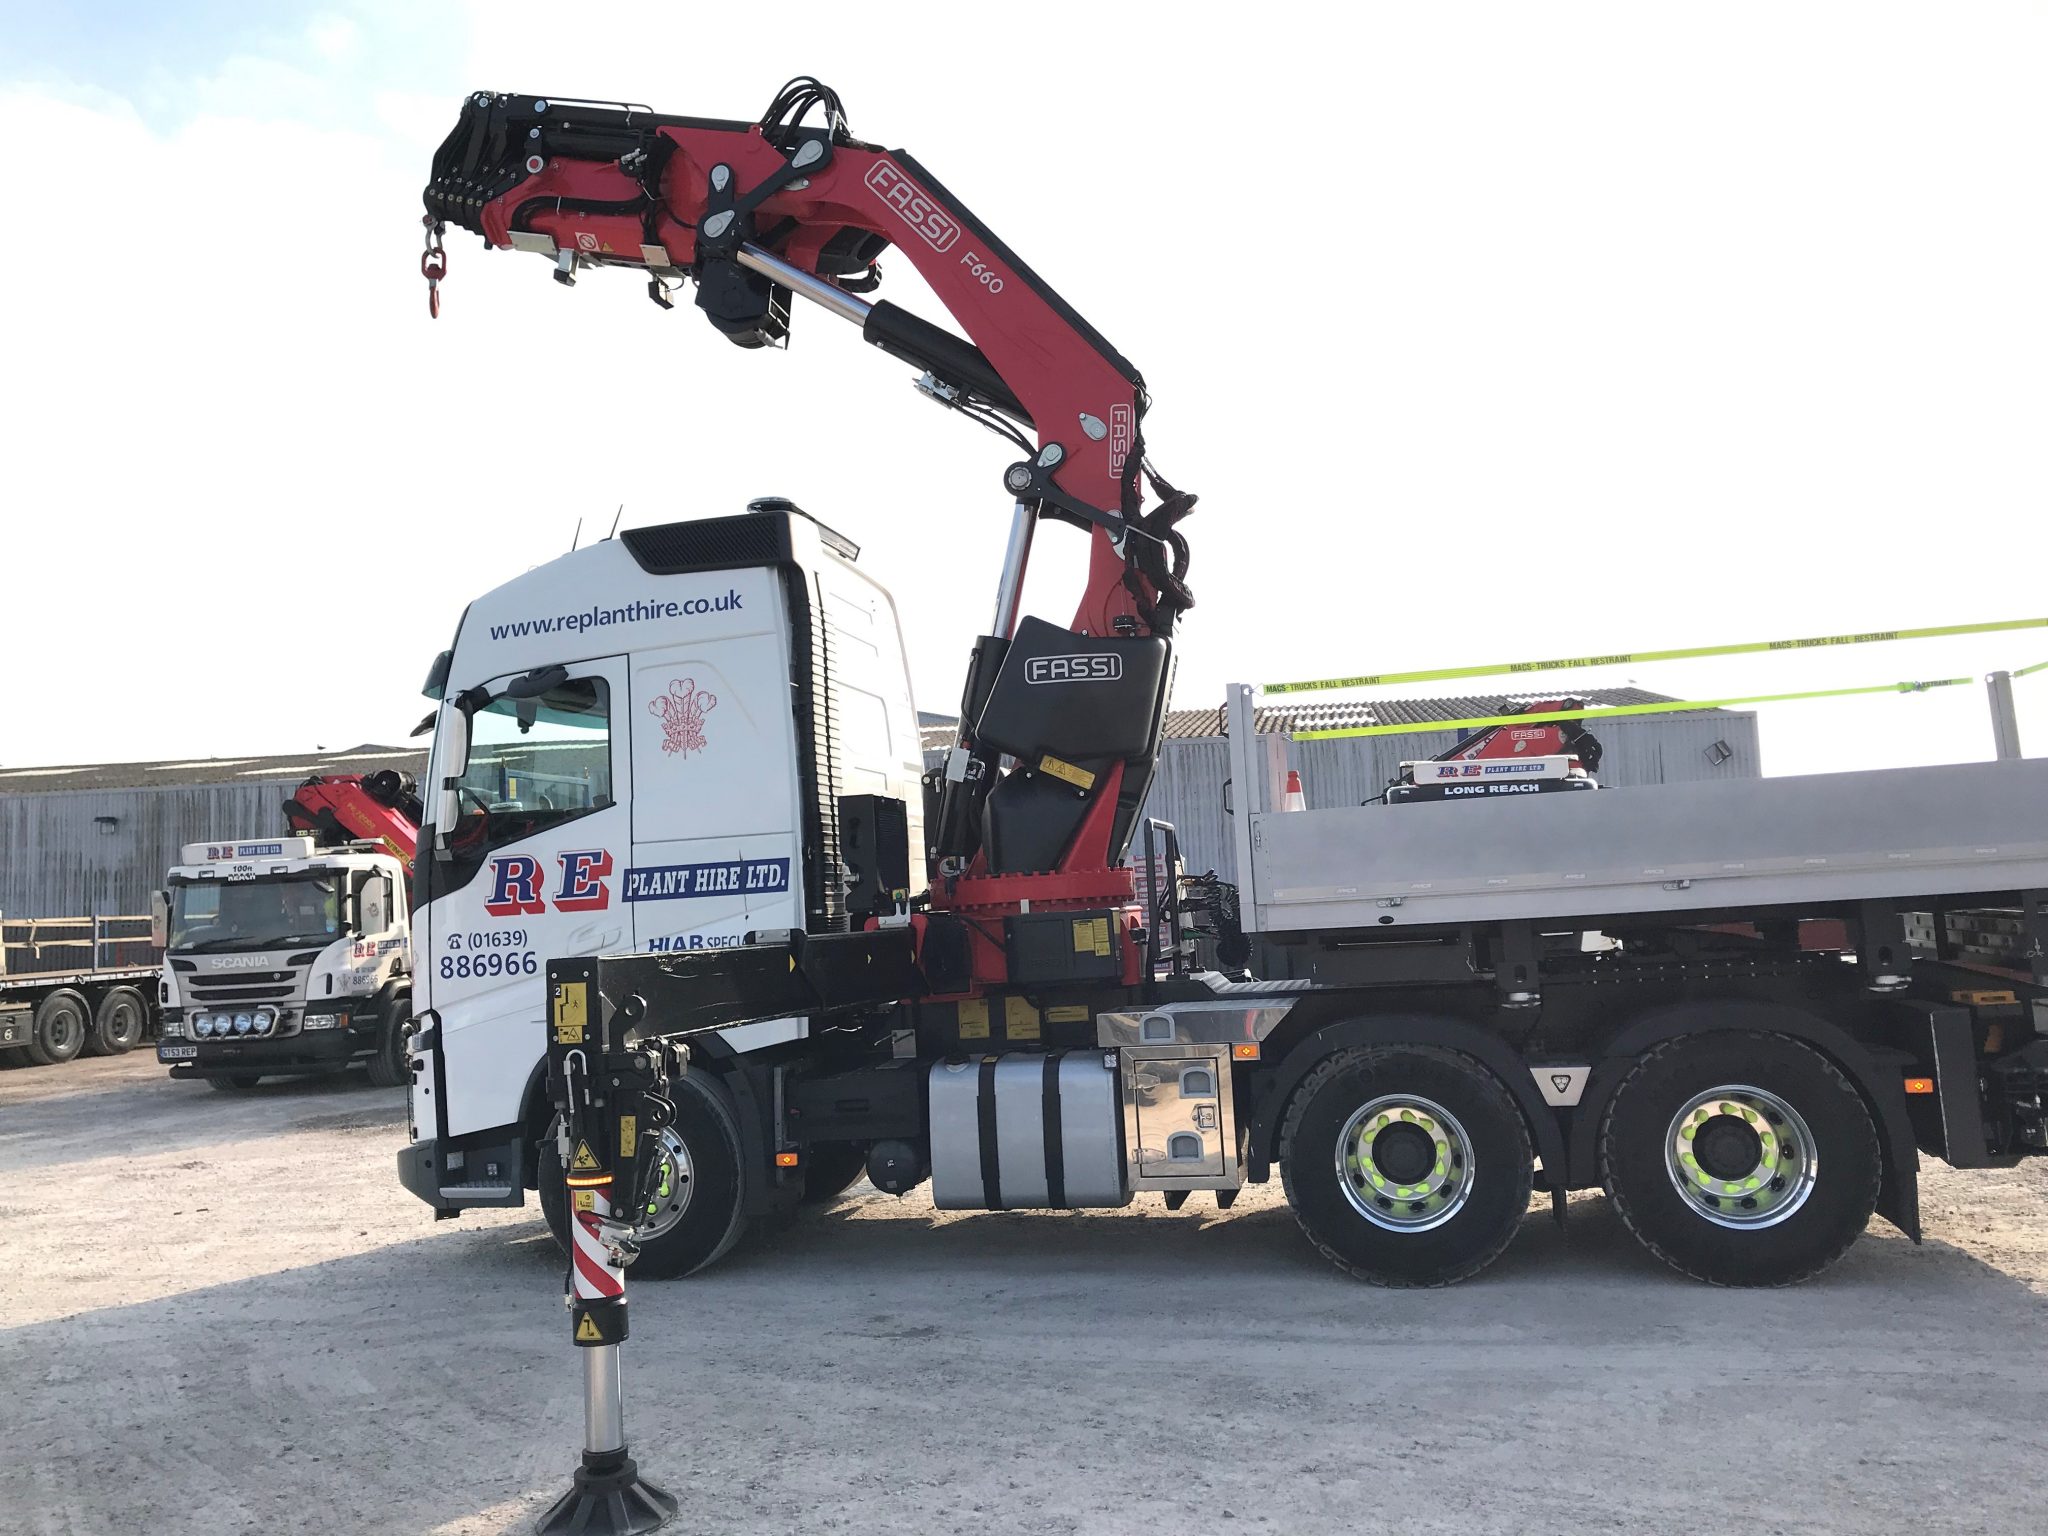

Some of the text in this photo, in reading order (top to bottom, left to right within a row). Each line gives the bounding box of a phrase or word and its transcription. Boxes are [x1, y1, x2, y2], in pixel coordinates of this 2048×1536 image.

[871, 166, 954, 246] FASSI
[960, 251, 1004, 294] F660
[1112, 410, 1127, 472] FASSI
[490, 589, 743, 641] www.replanthire.co.uk
[1830, 636, 1850, 645] FALL
[1854, 631, 1899, 643] RESTRAINT
[1032, 657, 1115, 680] FASSI
[1568, 658, 1587, 668] FALL
[1590, 654, 1632, 666] RESTRAINT
[1320, 680, 1338, 689] FALL
[1341, 676, 1381, 688] RESTRAINT
[1444, 783, 1540, 795] LONG REACH
[227, 872, 256, 881] REACH
[627, 870, 690, 896] PLANT
[695, 866, 741, 892] HIRE
[745, 864, 785, 888] LTD.
[468, 929, 528, 951] (01639)
[648, 935, 704, 952] HIAB
[211, 956, 269, 969] SCANIA
[440, 952, 538, 979] 886966
[555, 987, 561, 996] 2
